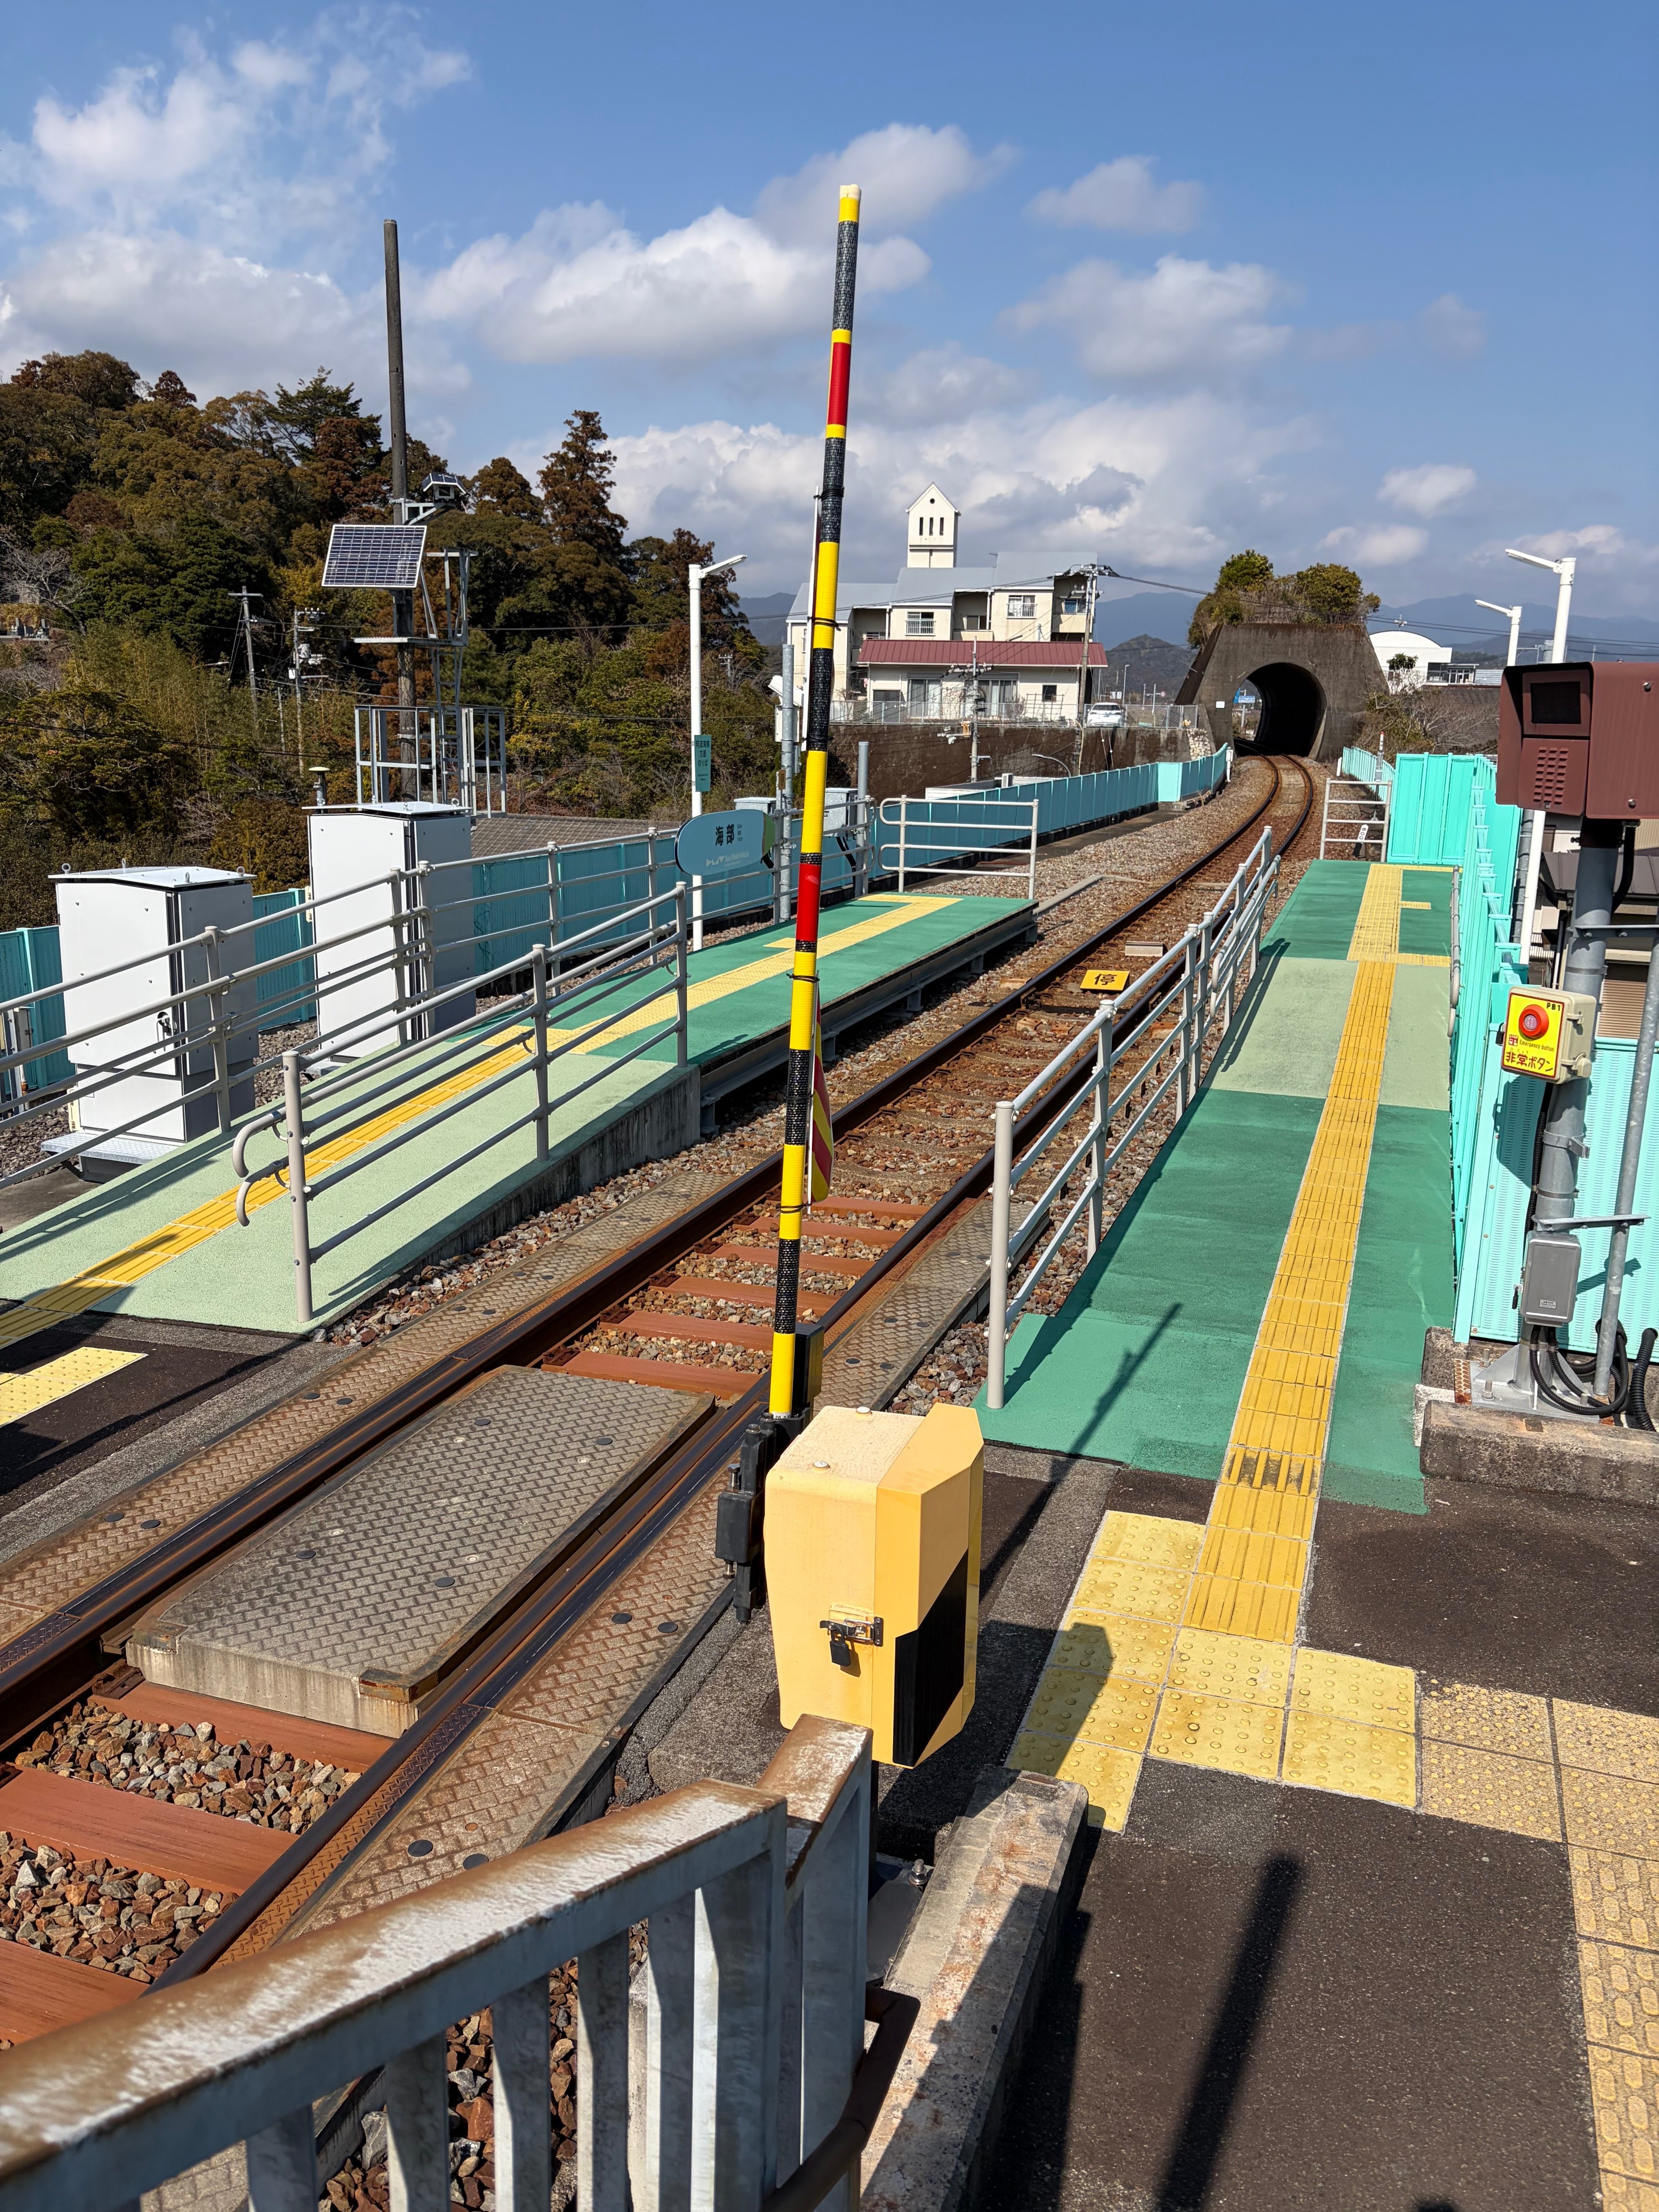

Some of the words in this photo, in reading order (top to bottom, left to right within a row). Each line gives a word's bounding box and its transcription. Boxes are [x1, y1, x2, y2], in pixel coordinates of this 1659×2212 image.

[715, 824, 734, 846] 海部
[1094, 974, 1117, 985] 停
[1547, 1003, 1560, 1011] PB1
[1520, 1039, 1540, 1049] Emergency
[1506, 1051, 1553, 1072] 非常ボタン
